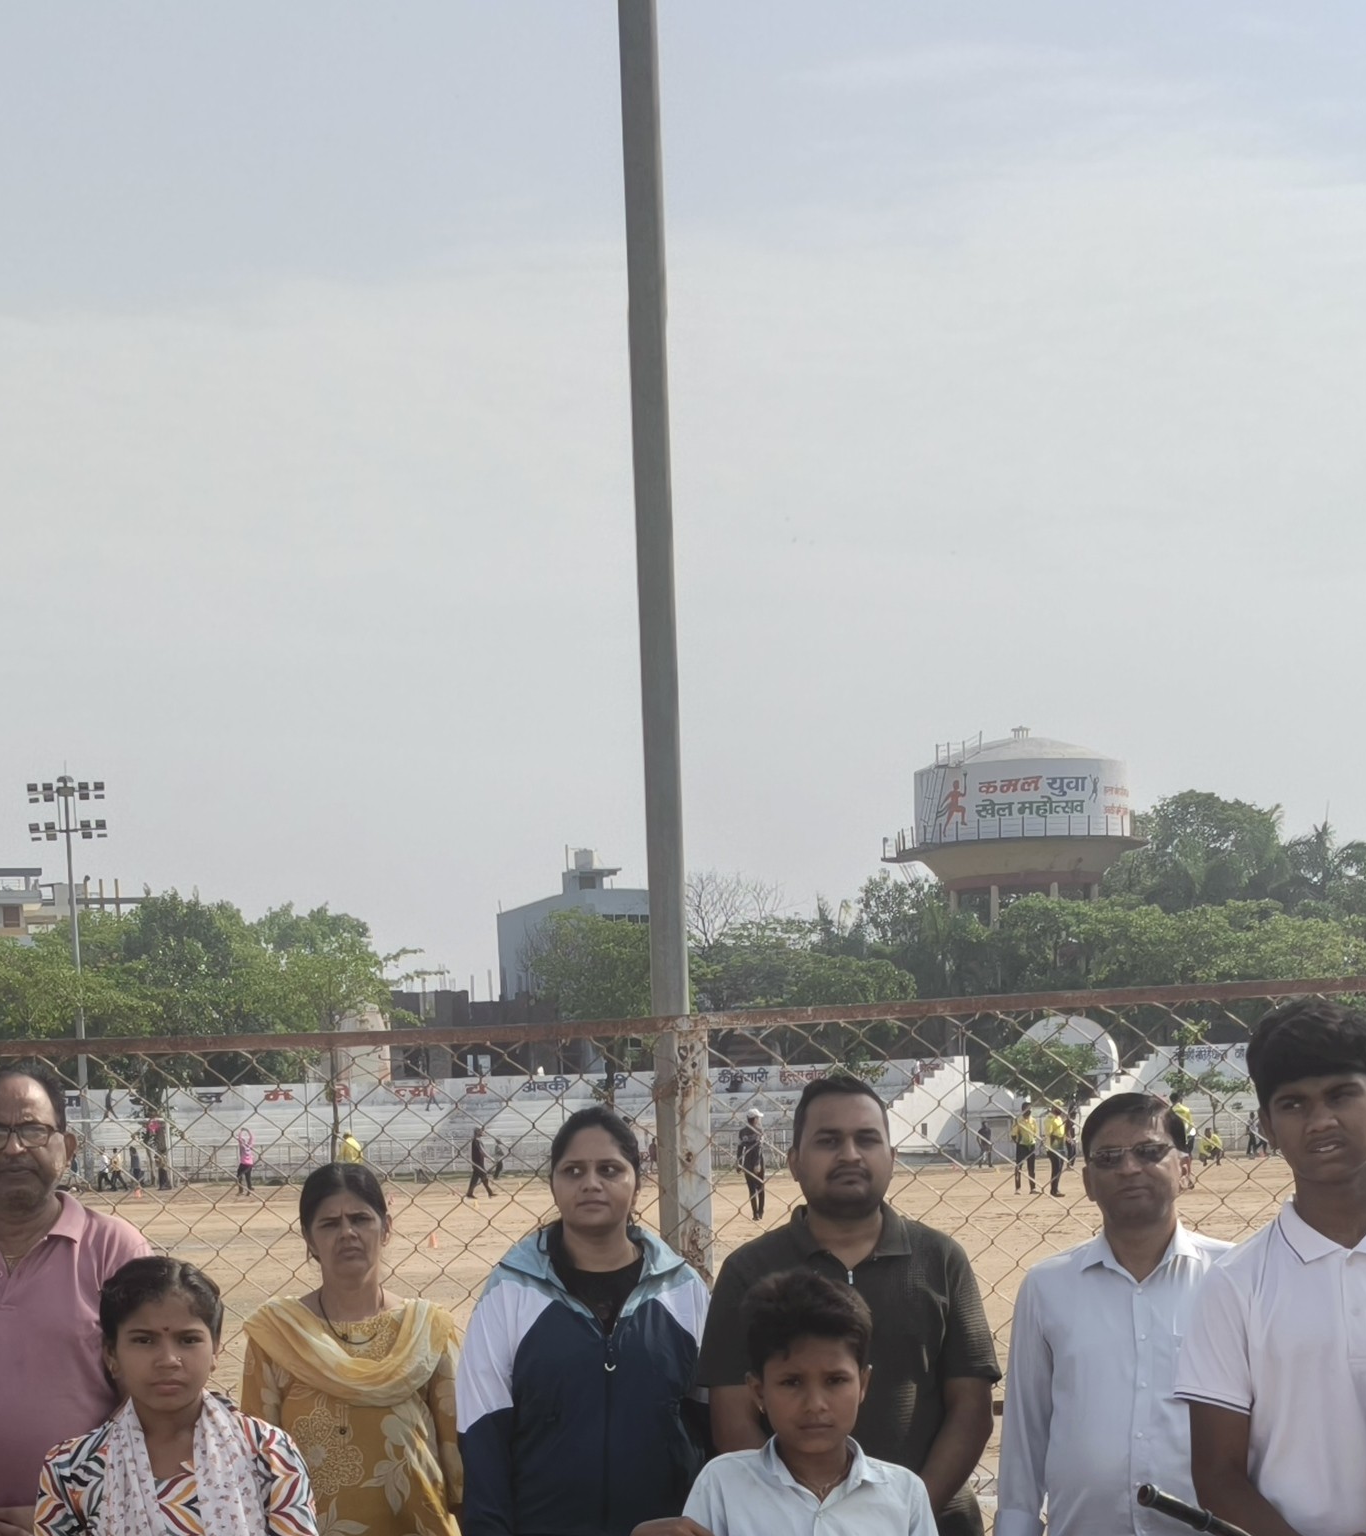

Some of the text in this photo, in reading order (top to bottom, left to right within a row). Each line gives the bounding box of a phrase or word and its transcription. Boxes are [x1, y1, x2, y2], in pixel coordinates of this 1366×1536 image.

[978, 775, 1042, 794] कमल
[1046, 776, 1087, 796] युवा
[975, 799, 1014, 818] खेल
[1017, 795, 1085, 818] महोत्सव
